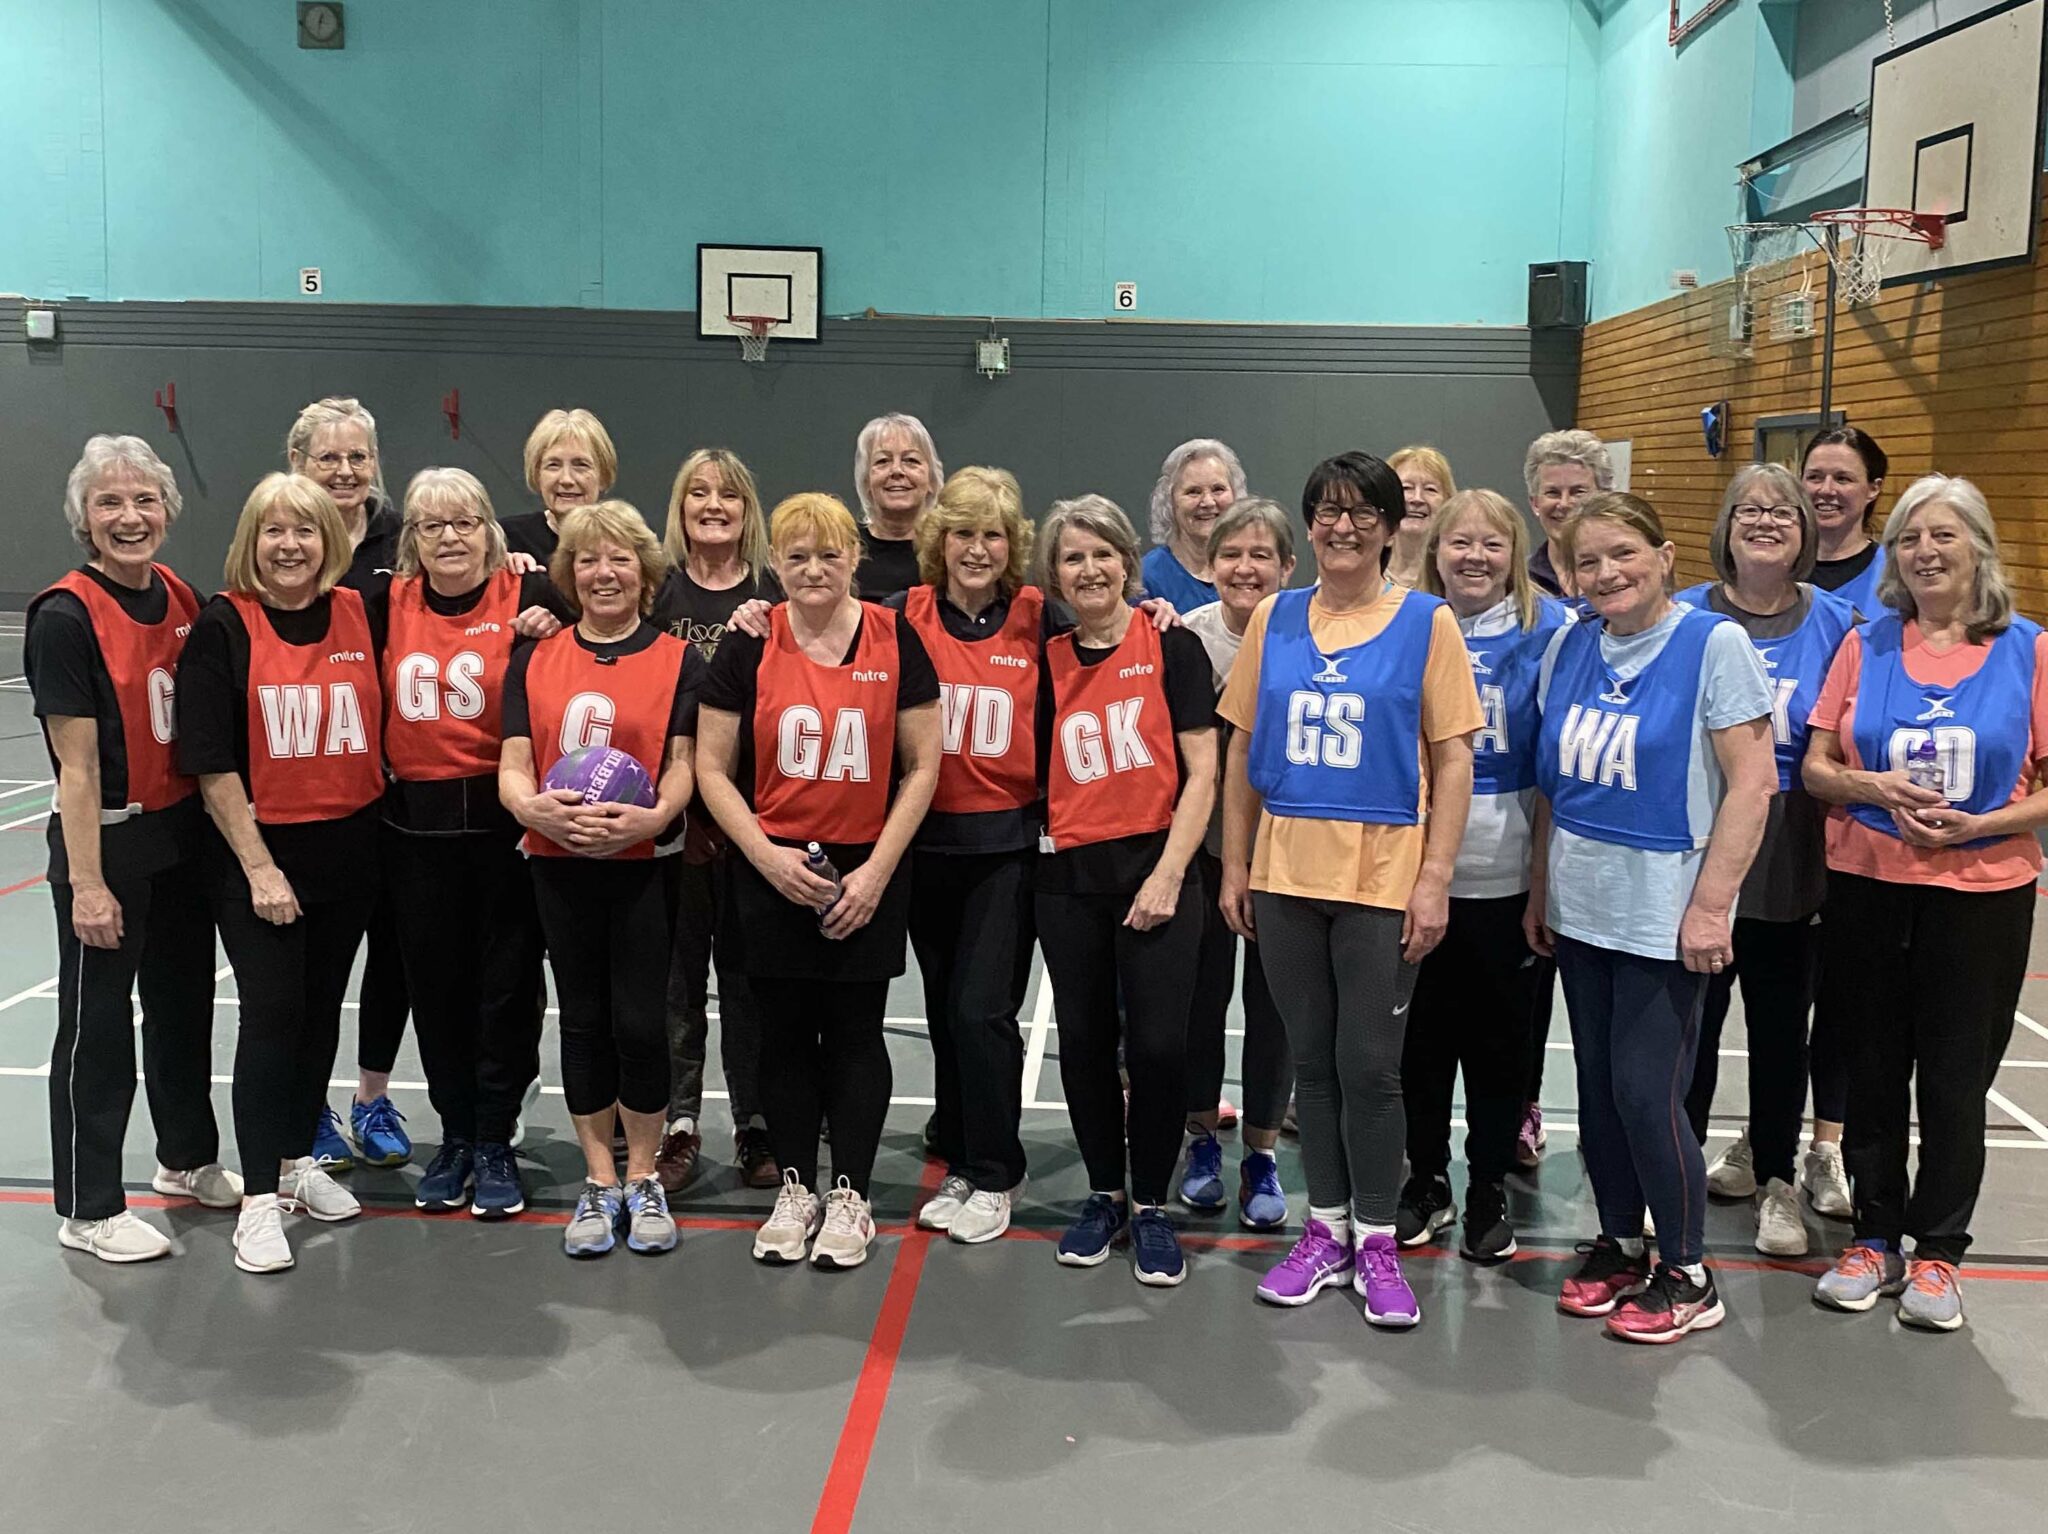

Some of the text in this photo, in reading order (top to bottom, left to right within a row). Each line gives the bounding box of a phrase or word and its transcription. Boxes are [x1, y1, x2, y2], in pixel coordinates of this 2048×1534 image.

[305, 275, 318, 292] 5
[1120, 290, 1133, 308] 6
[329, 650, 365, 664] mitre
[464, 622, 501, 636] mitre
[396, 650, 486, 722] GS
[852, 669, 889, 682] mitre
[989, 654, 1028, 669] mitre
[1119, 662, 1154, 679] mitre
[147, 667, 176, 744] G
[257, 681, 369, 759] WA
[1286, 690, 1366, 769] GS
[1472, 683, 1510, 753] A
[777, 704, 871, 782] GA
[1060, 696, 1155, 784] GK
[1558, 703, 1640, 791] WA
[582, 749, 625, 806] GILBER
